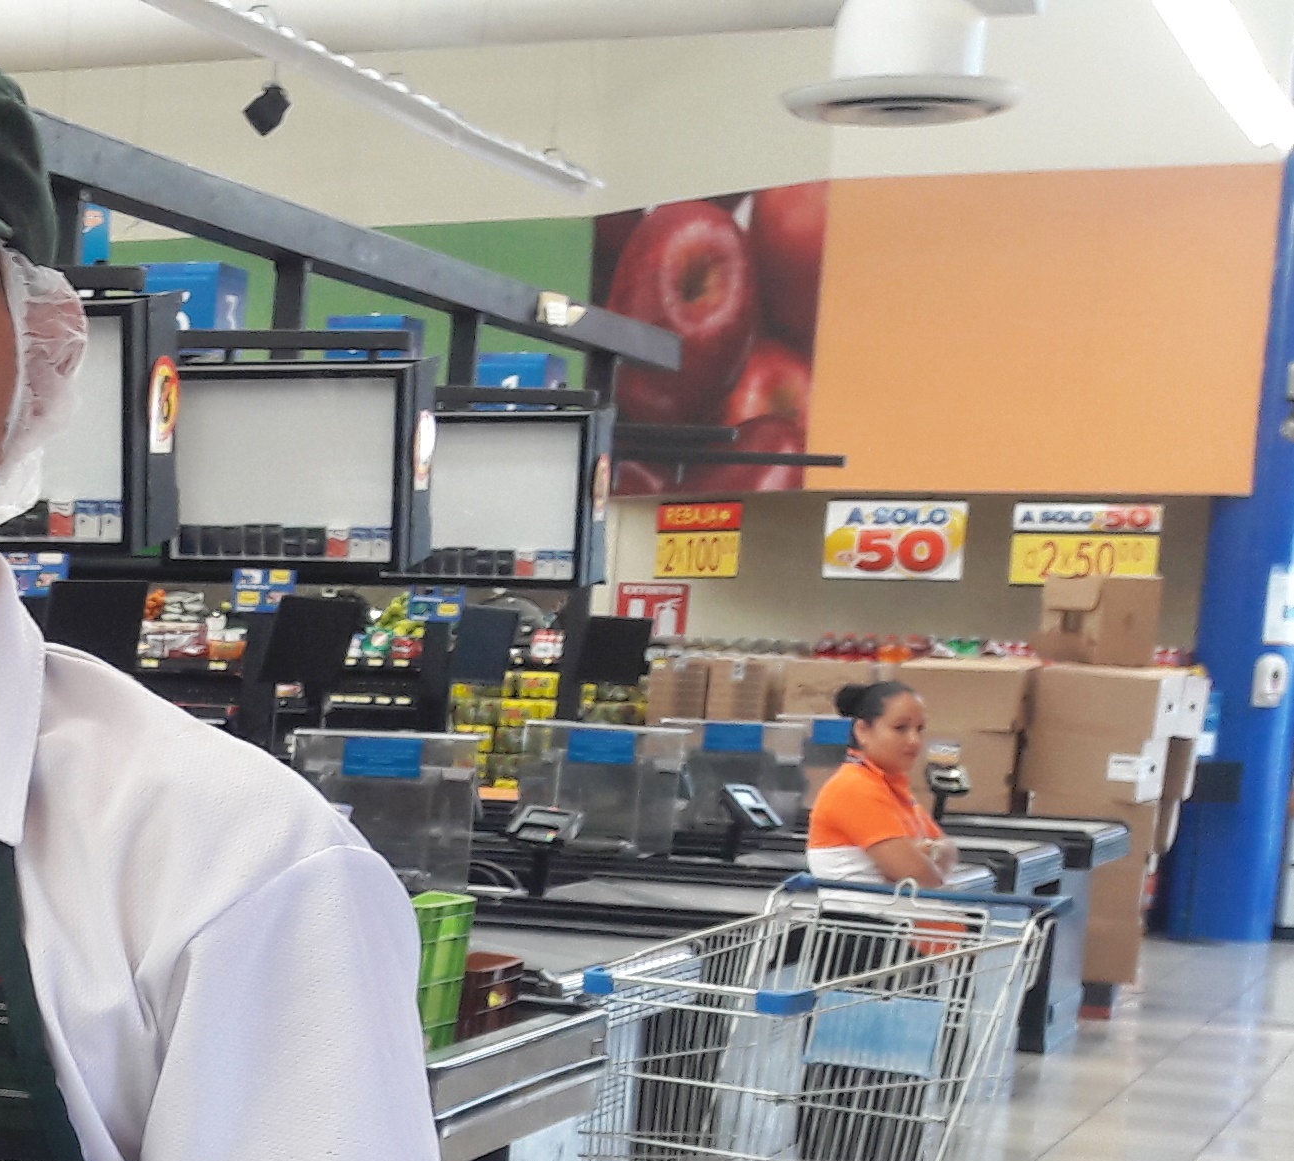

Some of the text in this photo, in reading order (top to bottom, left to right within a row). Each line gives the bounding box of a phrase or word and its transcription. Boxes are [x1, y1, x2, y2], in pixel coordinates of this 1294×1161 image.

[845, 507, 949, 526] A SOLO
[1021, 511, 1035, 523] A
[1104, 509, 1153, 529] 50
[855, 528, 947, 573] 50
